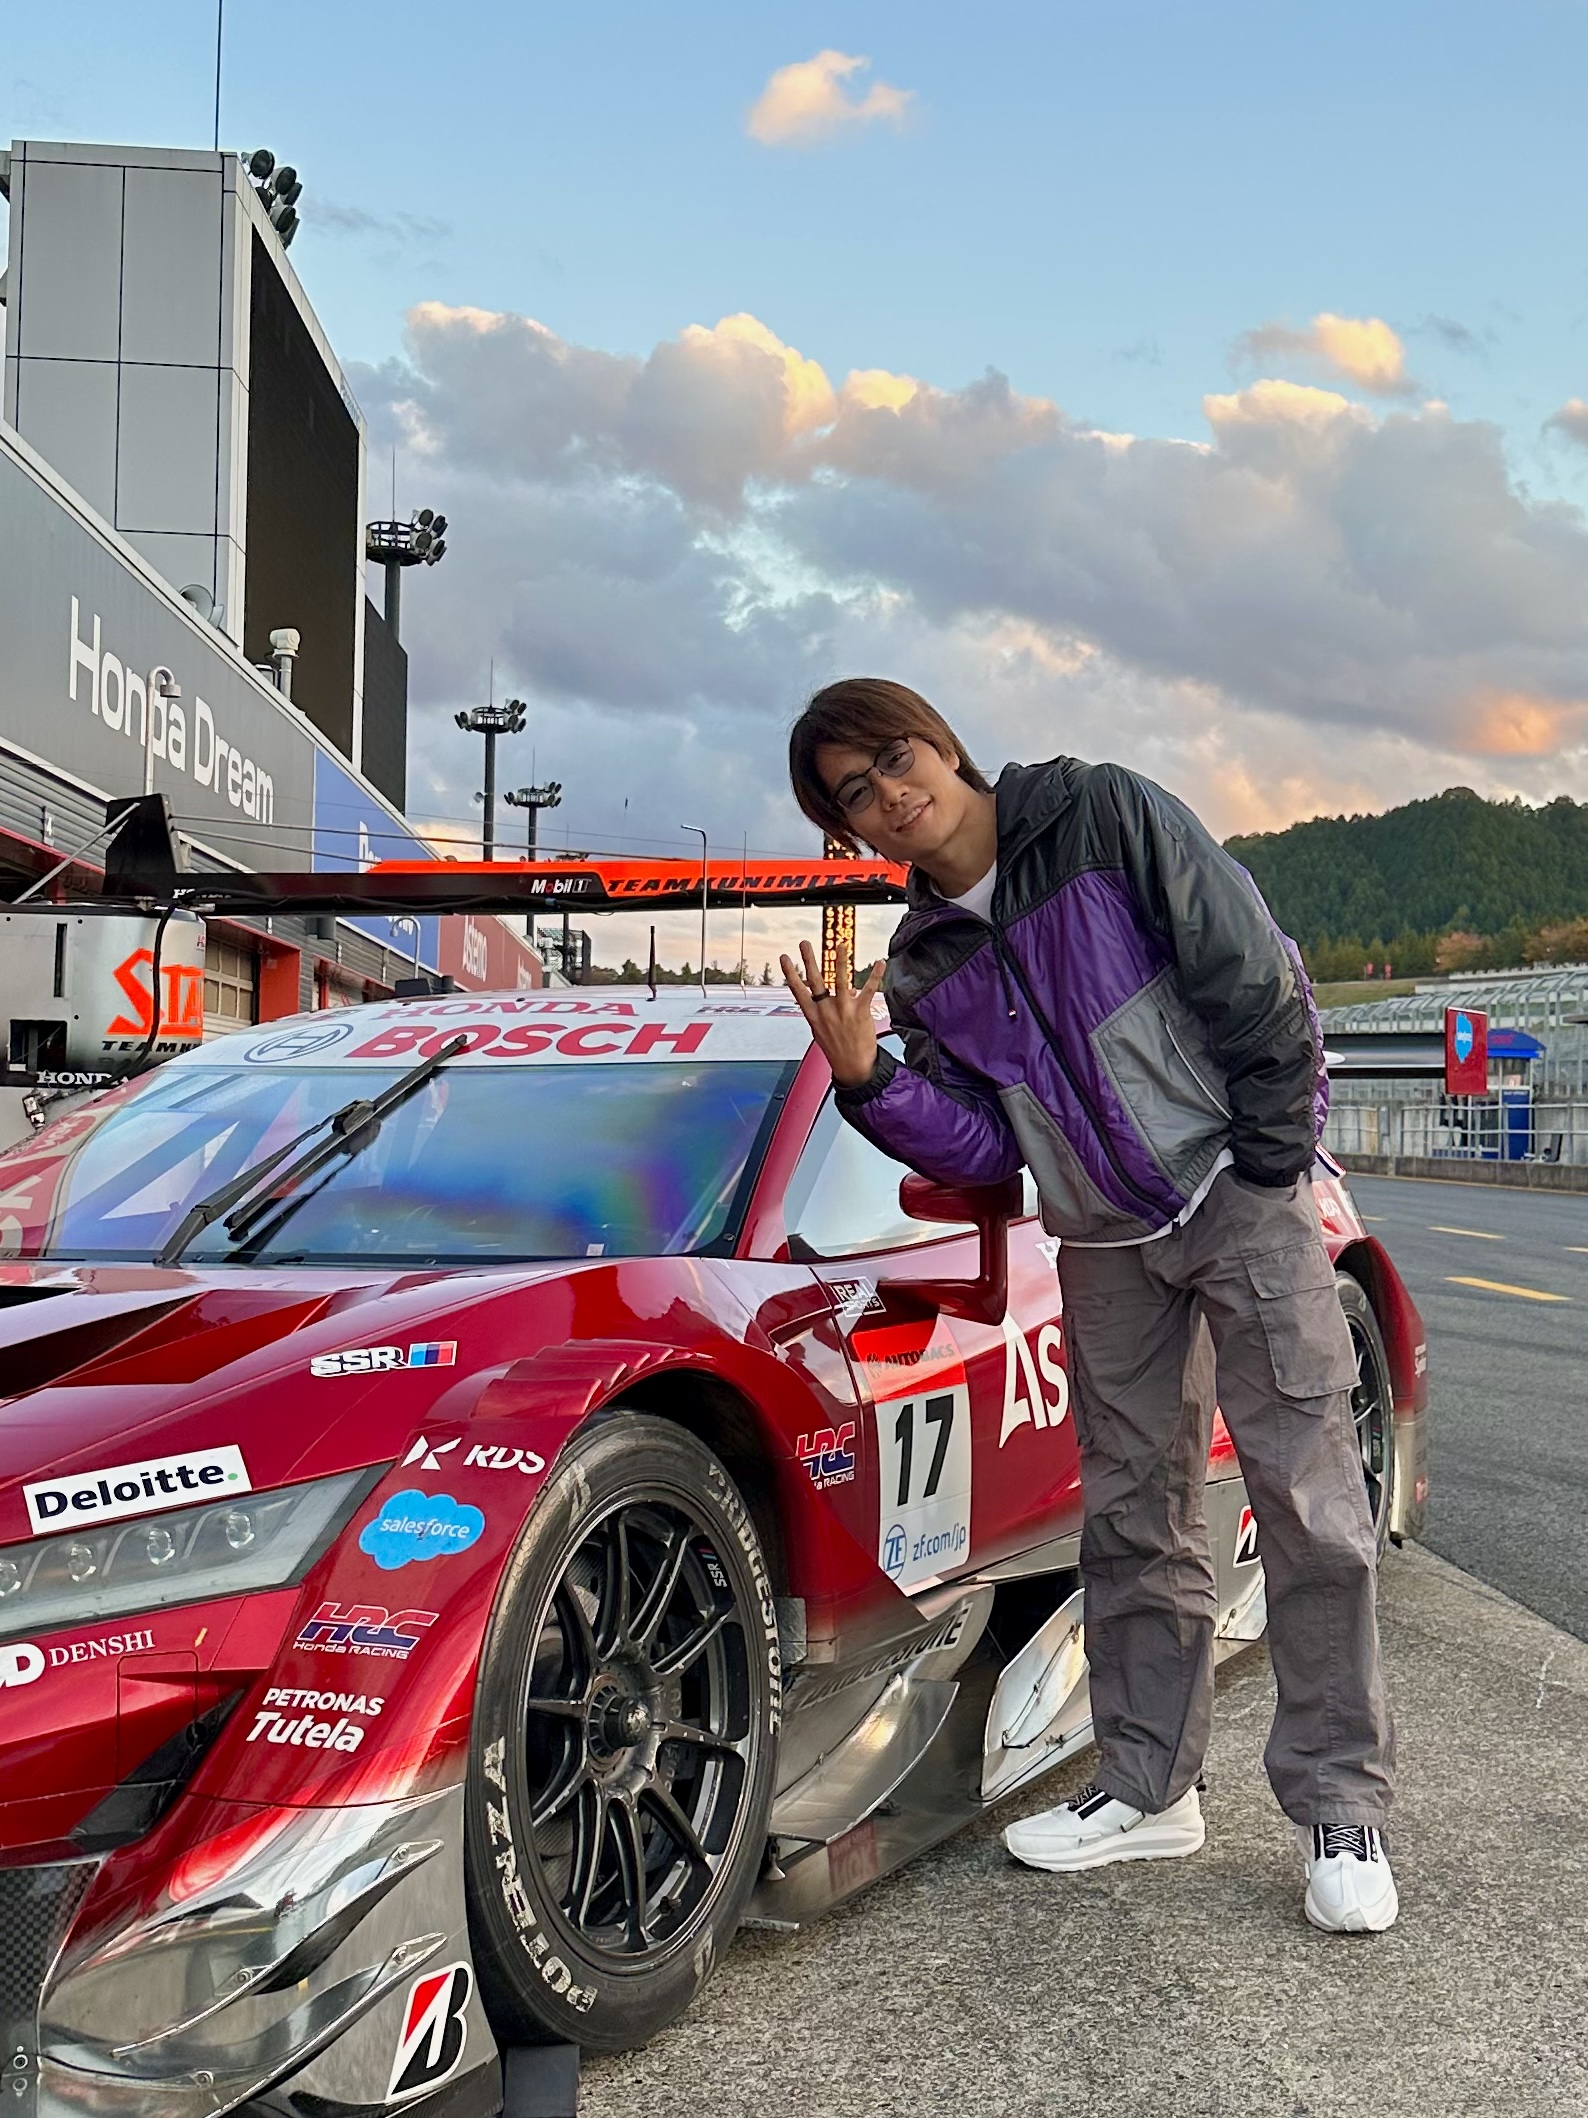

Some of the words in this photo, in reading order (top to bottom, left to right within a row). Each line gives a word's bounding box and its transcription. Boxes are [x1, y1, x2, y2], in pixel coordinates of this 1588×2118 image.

[69, 595, 186, 772] Honda
[194, 696, 274, 824] Dream
[530, 878, 573, 894] Mobil
[607, 878, 693, 892] TEAM
[370, 1001, 640, 1020] HONDA
[101, 1040, 178, 1053] TEAM
[344, 1022, 713, 1058] BOSCH
[310, 1346, 407, 1378] SSR
[884, 1344, 956, 1371] AUTOBACS
[796, 1421, 856, 1480] HRC
[895, 1393, 954, 1507] 17
[380, 1516, 471, 1540] salesforce
[912, 1522, 967, 1562] zf.com/jp
[297, 1601, 440, 1651] HRC
[49, 1629, 156, 1667] DENSHI
[293, 1640, 346, 1654] Honda
[349, 1645, 410, 1660] RACING
[262, 1687, 386, 1717] PETRONAS
[245, 1711, 365, 1753] Tutela
